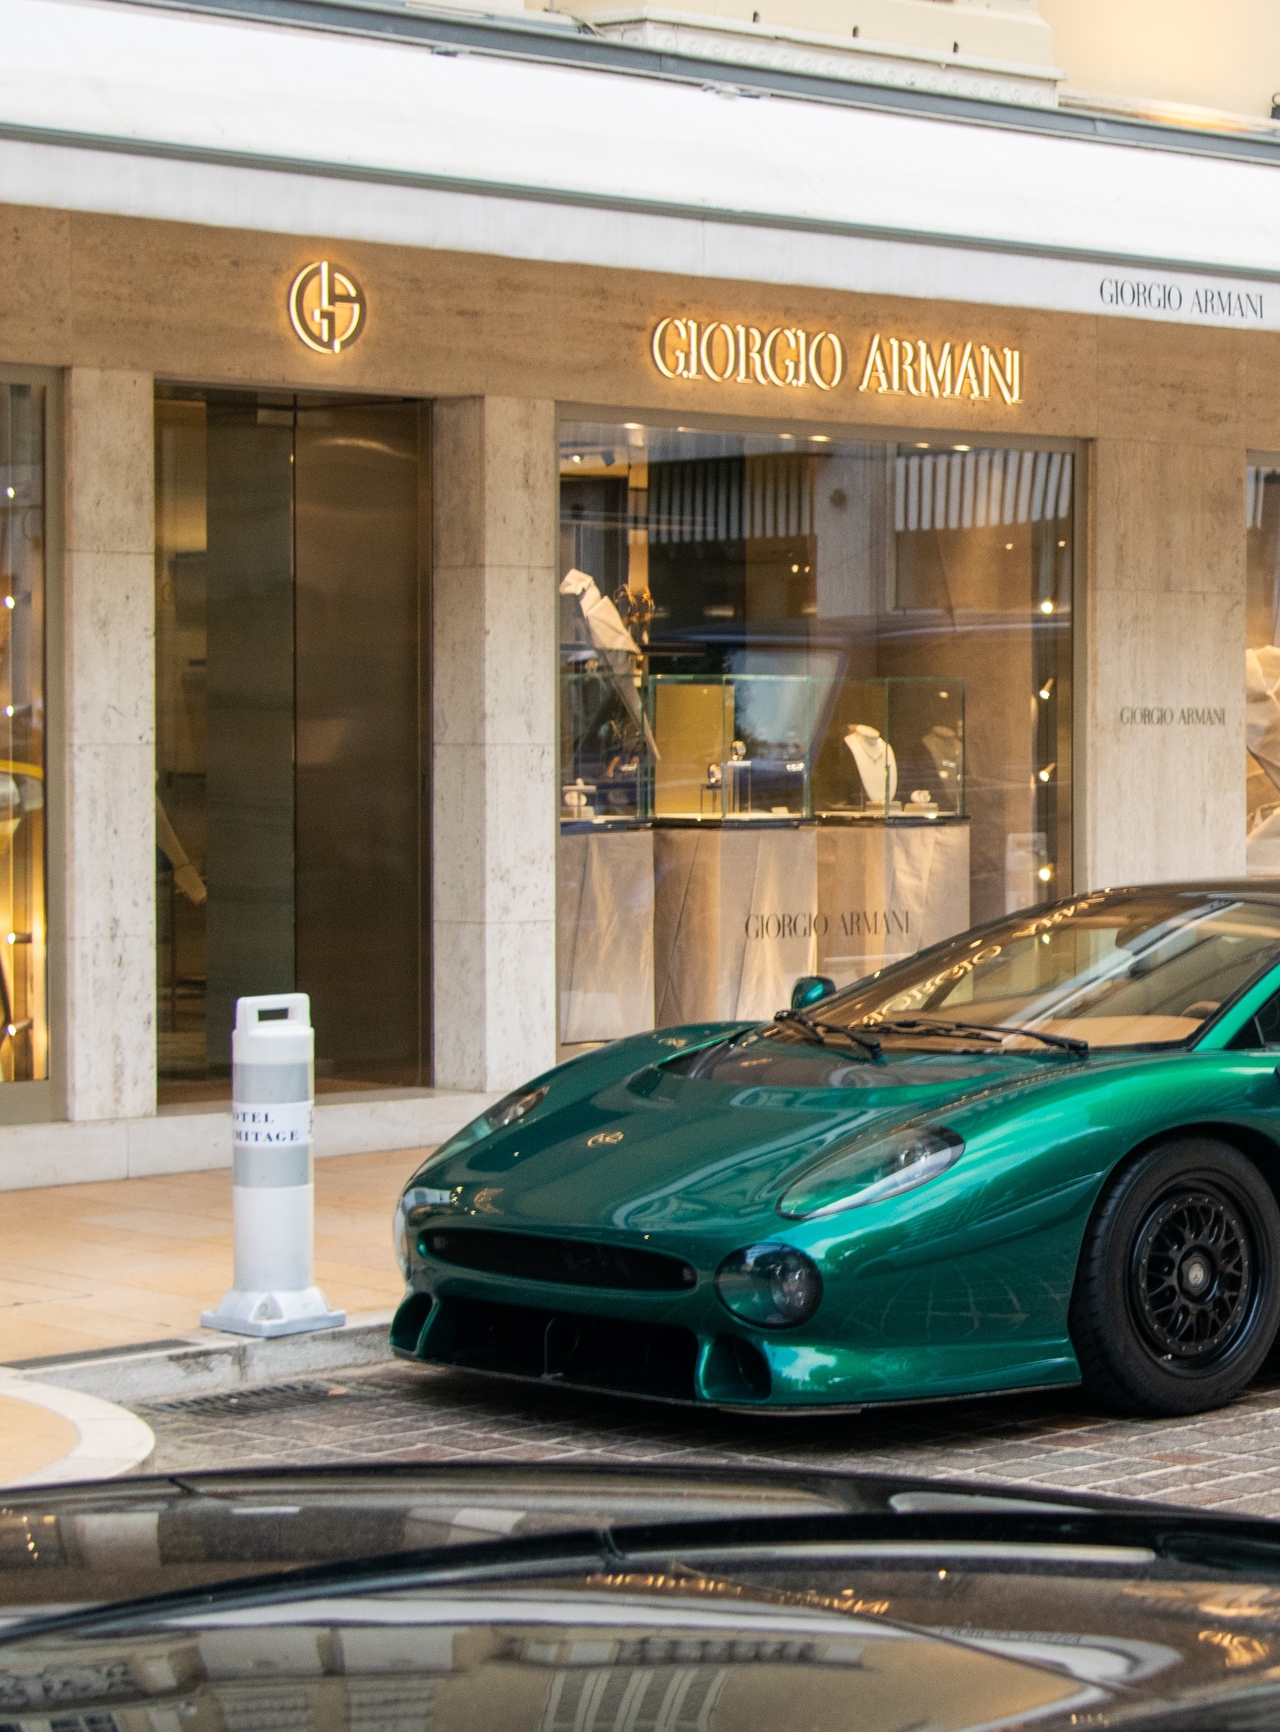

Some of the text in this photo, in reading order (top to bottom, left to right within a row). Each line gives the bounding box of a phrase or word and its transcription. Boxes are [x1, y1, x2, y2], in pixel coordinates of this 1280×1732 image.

[1099, 277, 1265, 319] GIORGIO ARMANI
[651, 316, 1024, 405] GIORGIO ARMANI
[1120, 706, 1226, 725] GIORGIO ARMANI
[744, 910, 910, 940] GIORGIO ARMANI
